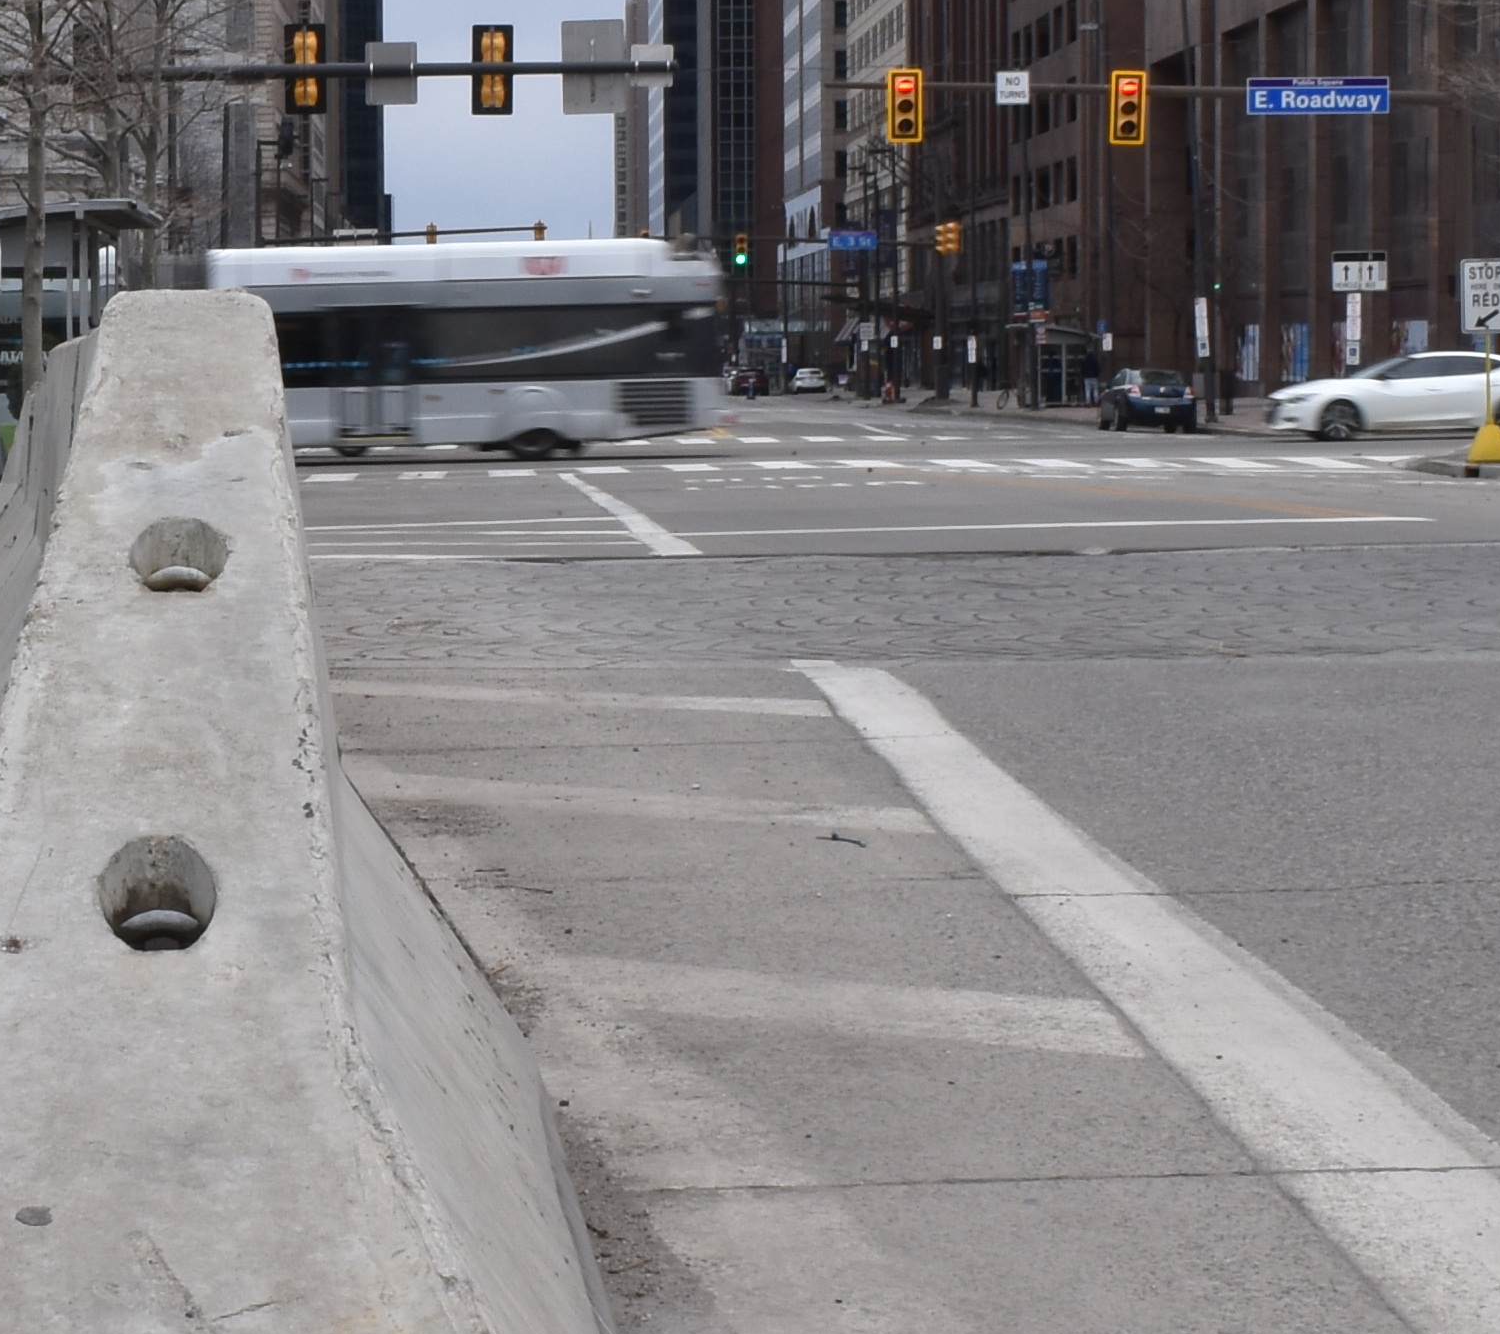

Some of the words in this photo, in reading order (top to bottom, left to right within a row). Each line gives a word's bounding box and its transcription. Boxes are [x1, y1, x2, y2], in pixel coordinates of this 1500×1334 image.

[1005, 76, 1021, 87] NO
[1254, 90, 1274, 109] E.
[1281, 90, 1382, 112] Roadway
[1472, 292, 1500, 308] RED
